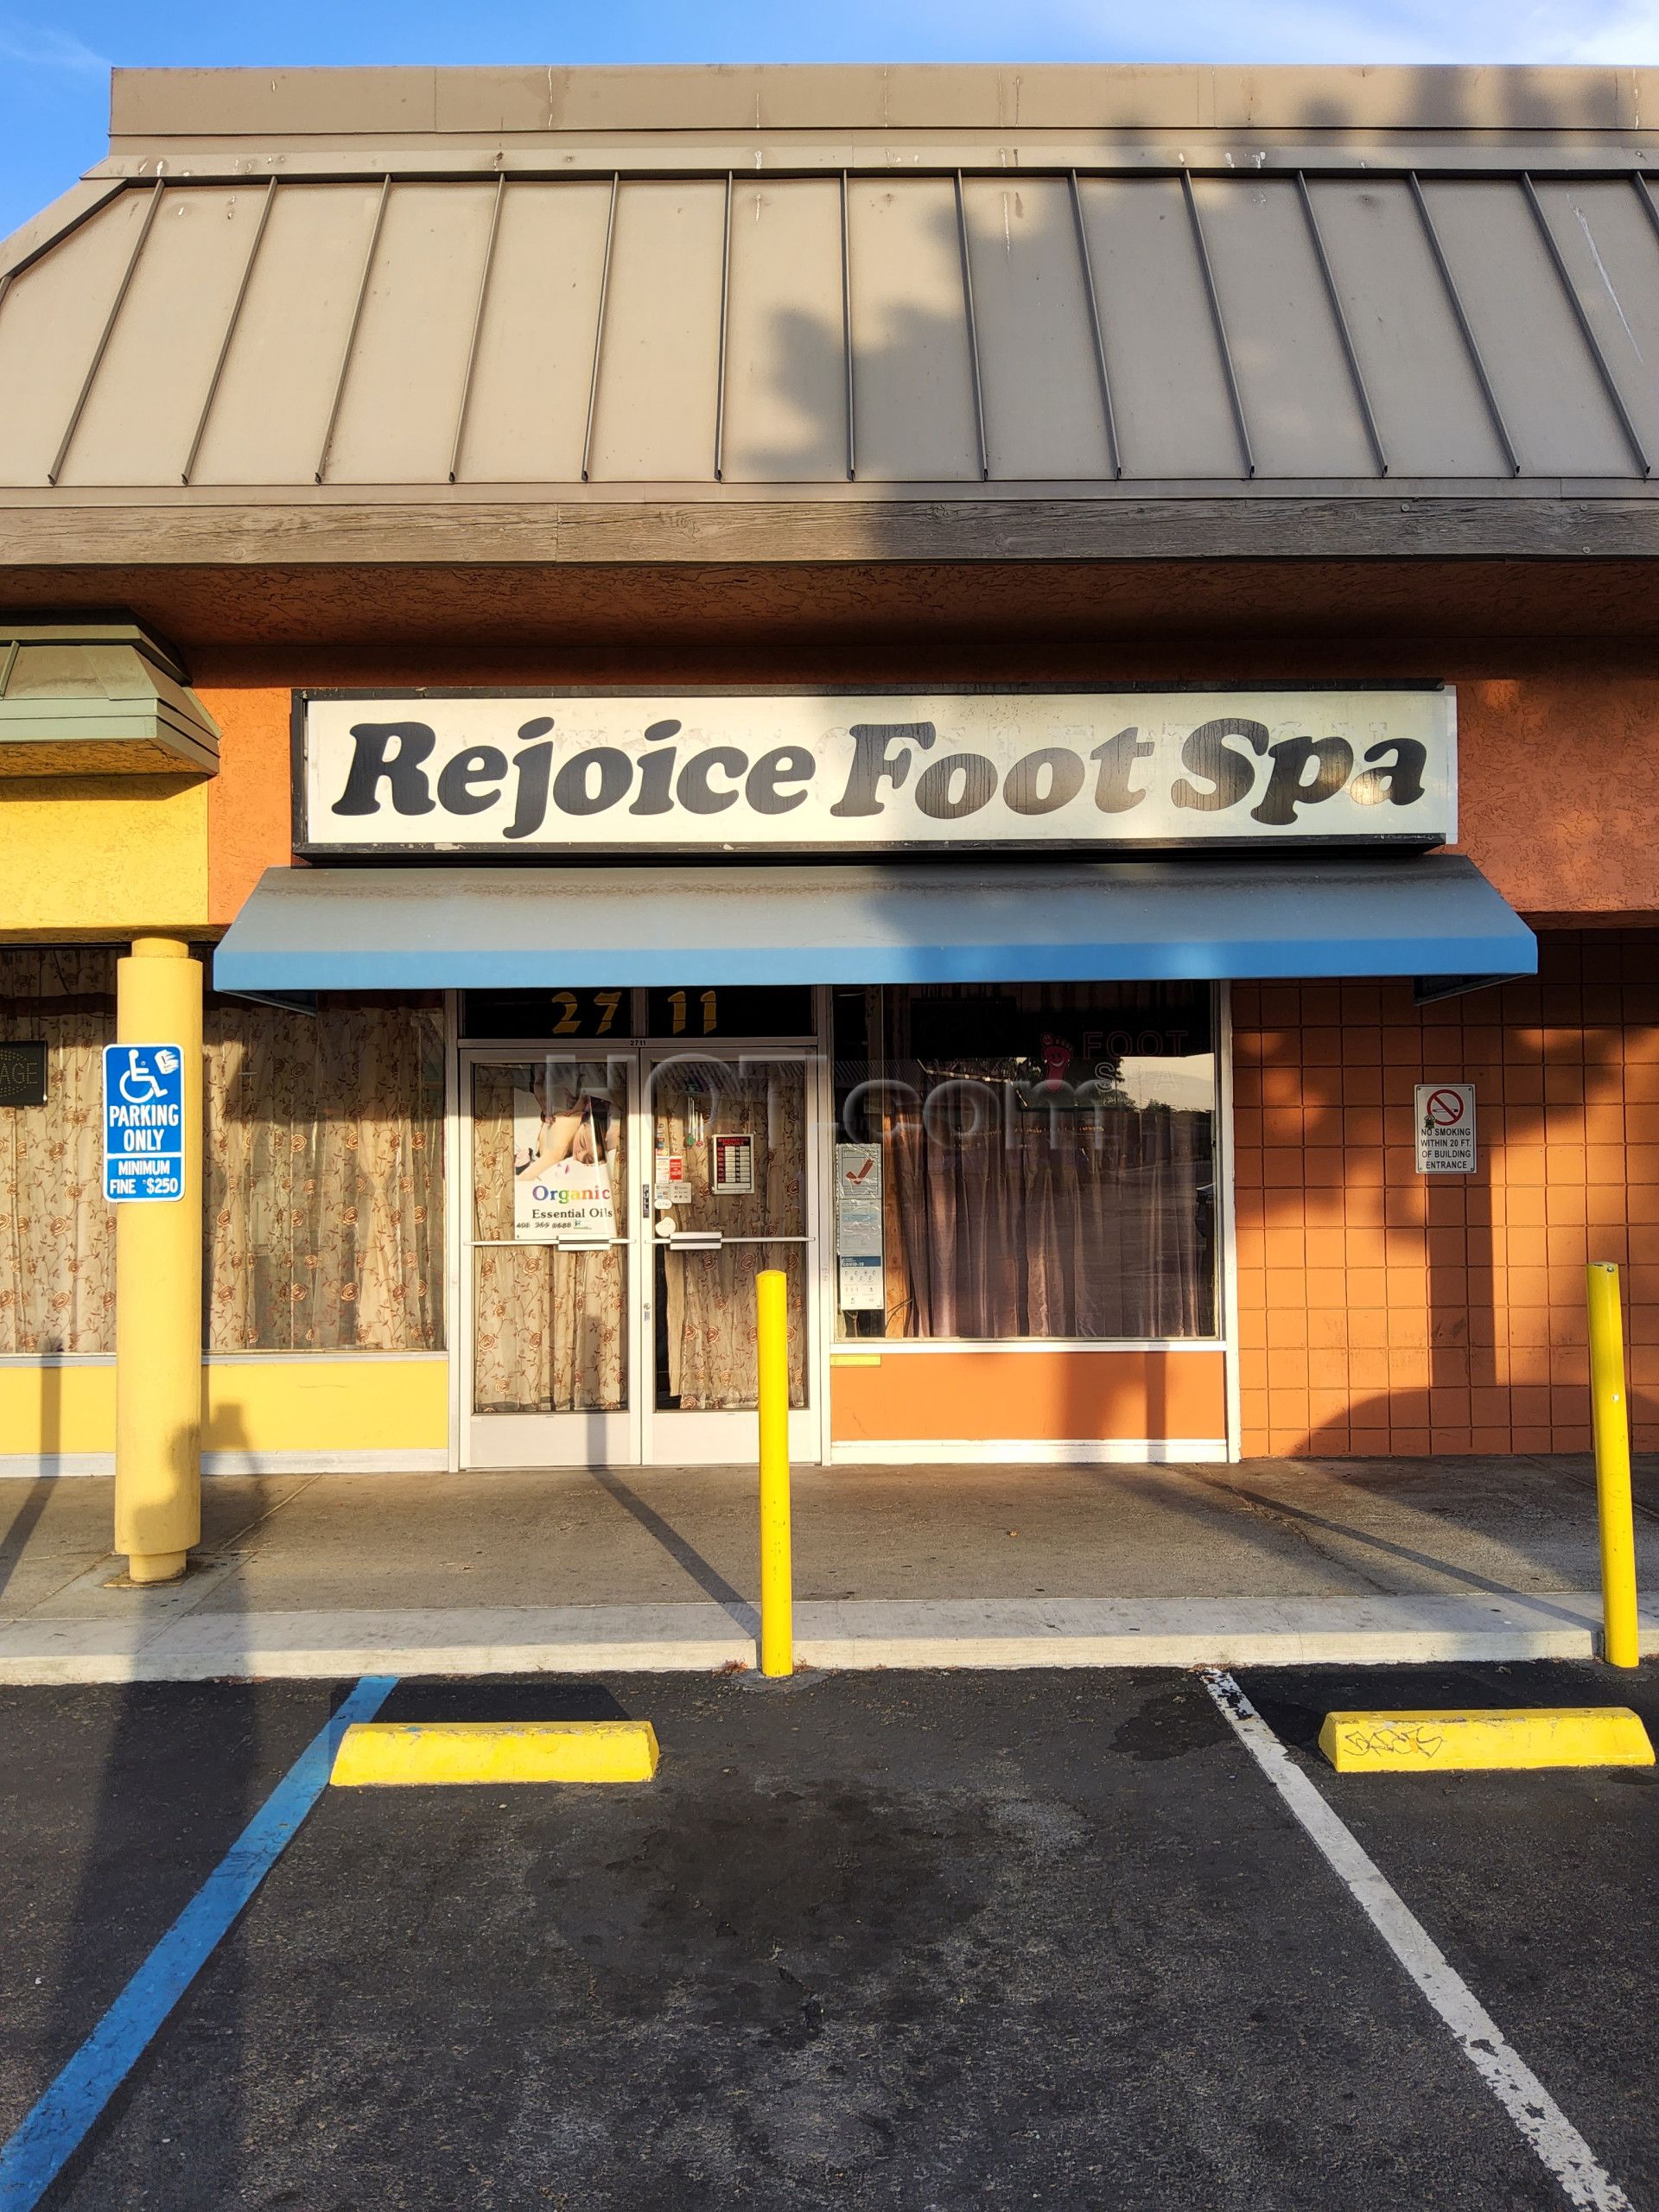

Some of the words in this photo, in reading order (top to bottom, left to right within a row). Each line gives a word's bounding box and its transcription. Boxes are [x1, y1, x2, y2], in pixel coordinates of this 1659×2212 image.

[331, 716, 816, 839] Rejoice
[830, 721, 1154, 819] Foot
[1171, 717, 1427, 826] Spa
[1082, 1031, 1189, 1060] FOOT
[109, 1104, 179, 1127] PARKING
[124, 1129, 164, 1151] ONLY
[118, 1160, 170, 1175] MINIMUM
[110, 1179, 136, 1194] FINE
[146, 1178, 179, 1194] $250
[532, 1185, 611, 1204] Organic
[531, 1209, 585, 1219] Essential
[589, 1208, 613, 1218] Oils
